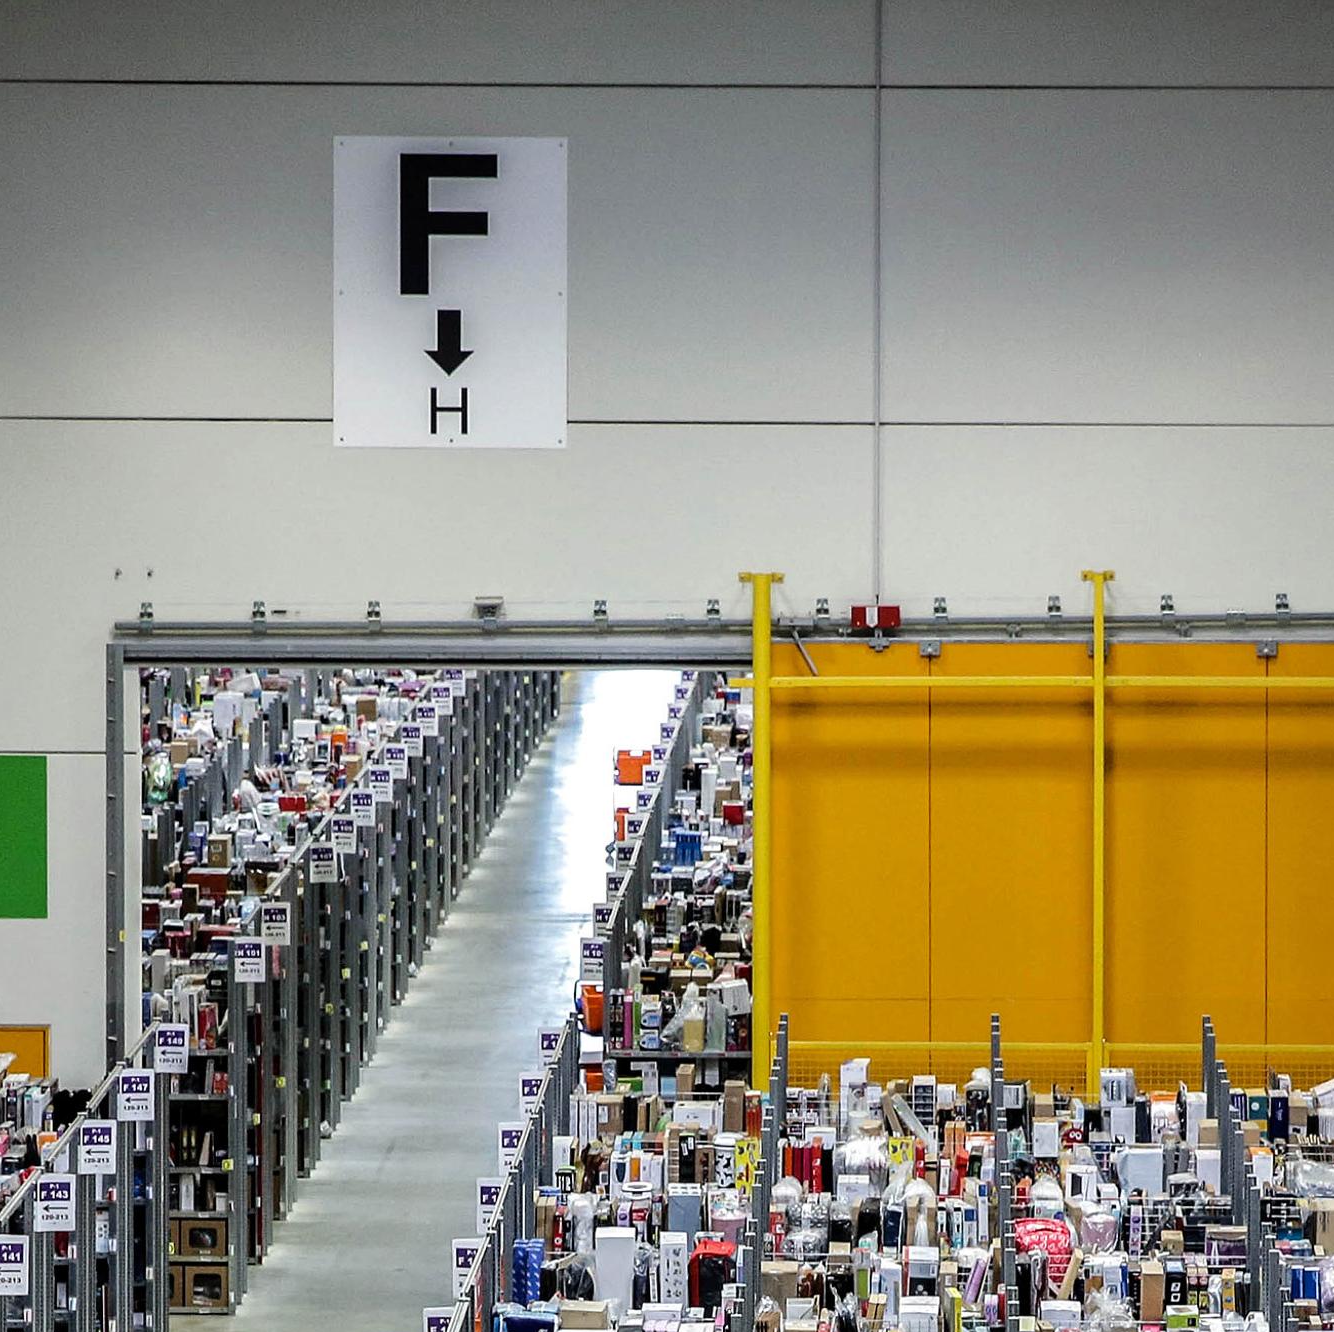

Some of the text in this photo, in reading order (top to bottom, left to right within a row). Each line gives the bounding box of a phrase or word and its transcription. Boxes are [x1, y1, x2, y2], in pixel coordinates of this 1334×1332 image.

[400, 153, 498, 295] F
[430, 387, 468, 434] H
[246, 949, 260, 957] 101
[543, 1040, 549, 1048] F
[123, 1083, 149, 1092] F 147
[524, 1086, 530, 1094] F
[83, 1134, 110, 1144] F 145
[503, 1138, 509, 1146] F
[41, 1190, 69, 1199] F 143
[482, 1194, 488, 1202] F
[1, 1252, 21, 1261] 141
[458, 1257, 464, 1265] F
